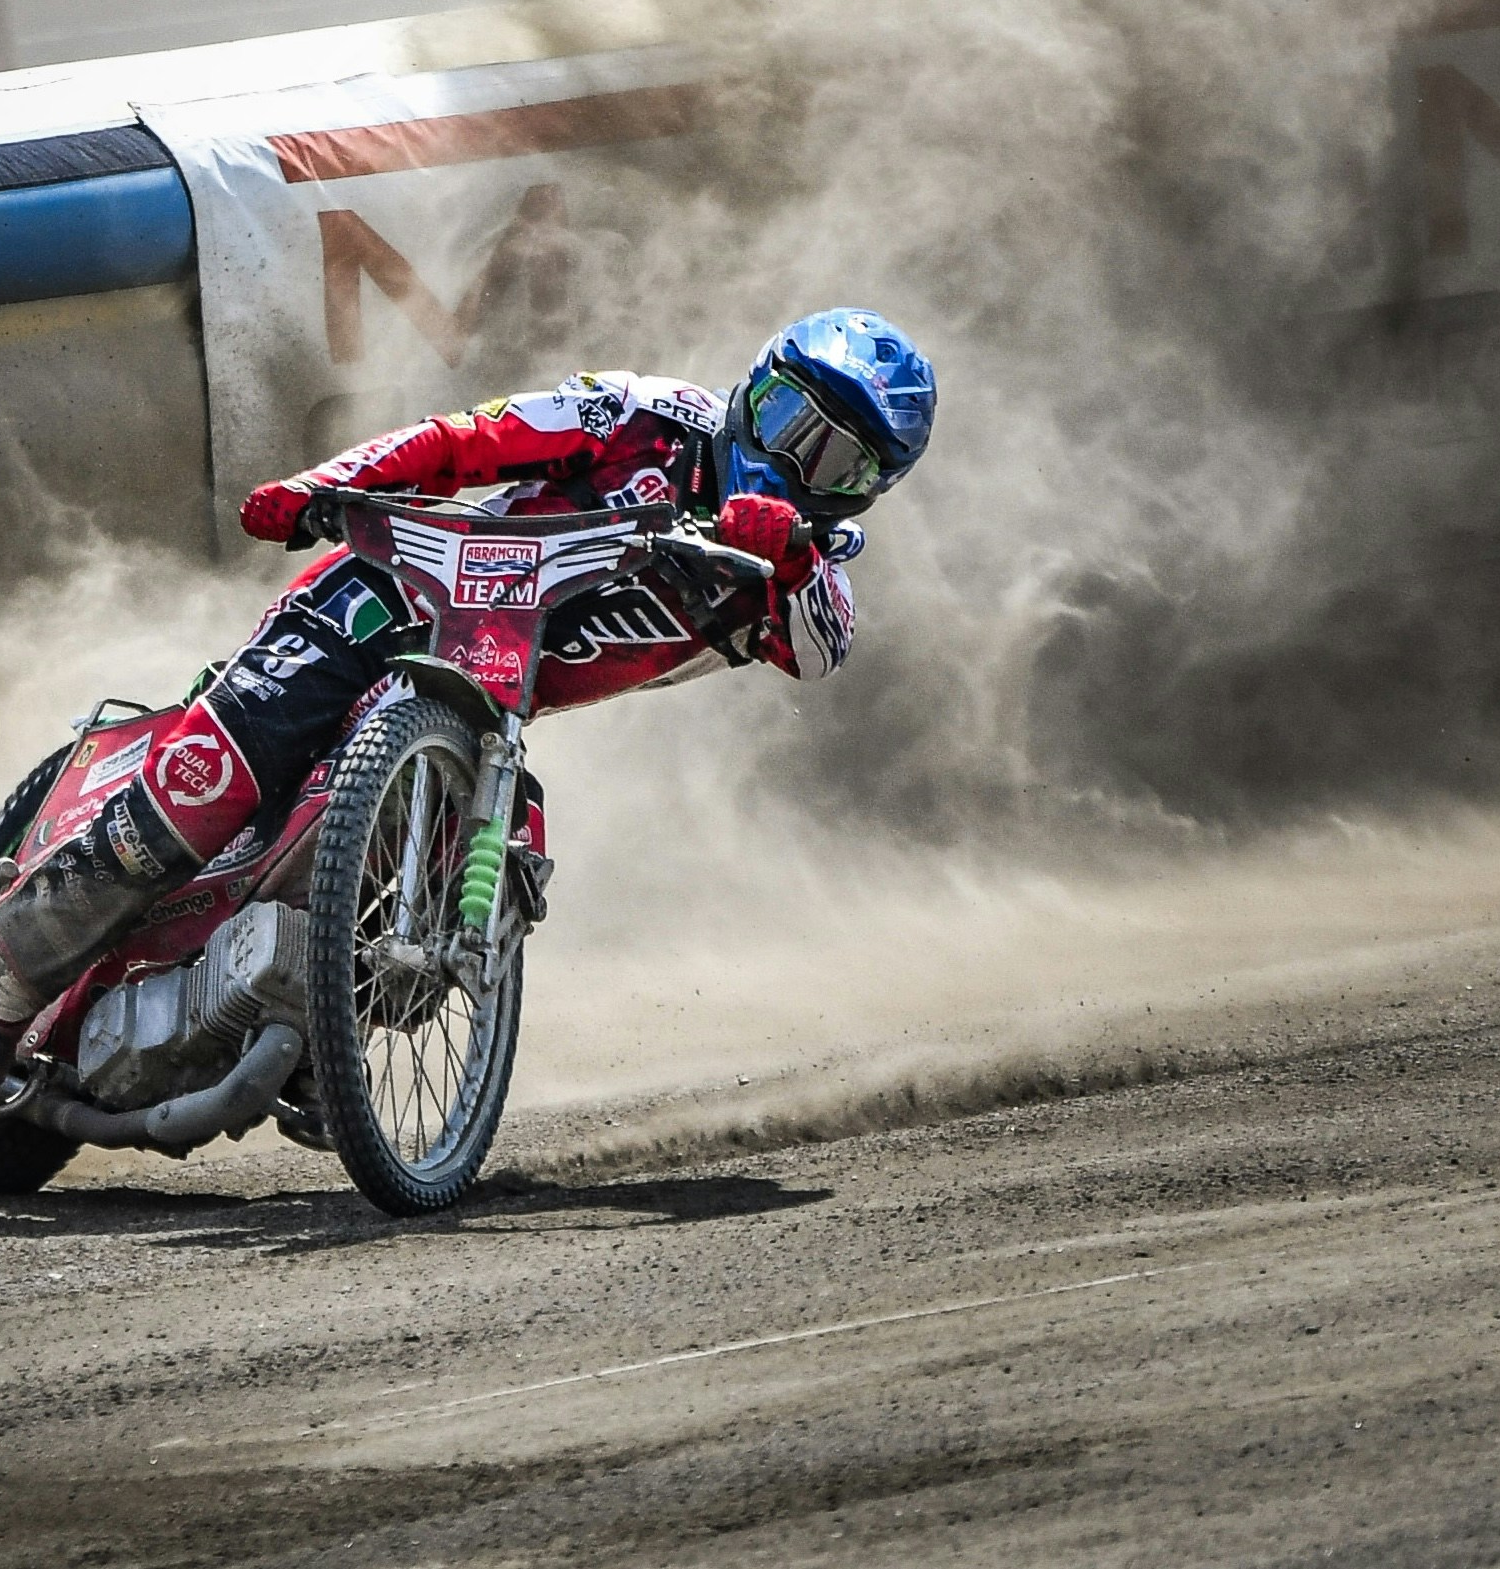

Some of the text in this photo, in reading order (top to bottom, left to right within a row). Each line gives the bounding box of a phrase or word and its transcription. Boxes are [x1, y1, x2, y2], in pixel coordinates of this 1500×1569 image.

[466, 546, 534, 560] ABRAMCZYK
[459, 580, 534, 604] TEAM
[175, 747, 213, 778] DUAL
[174, 764, 213, 795] TECH
